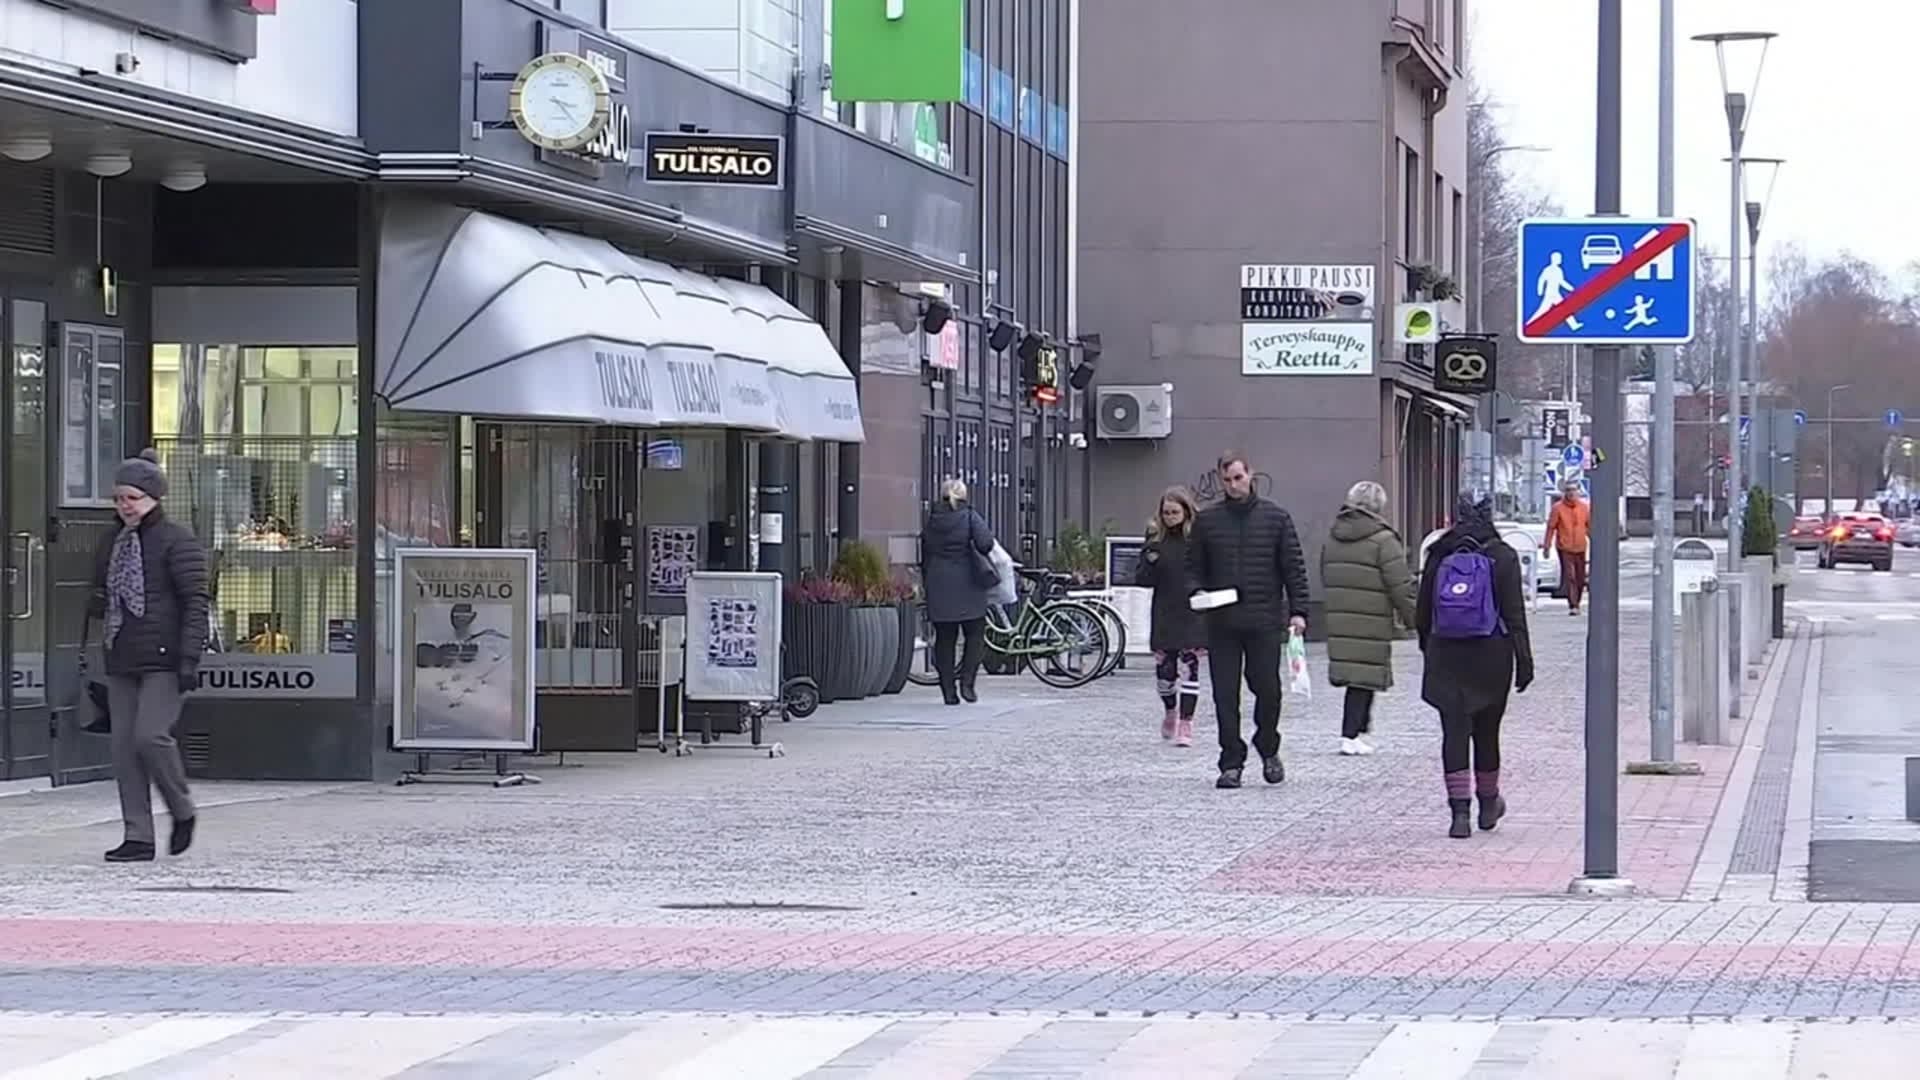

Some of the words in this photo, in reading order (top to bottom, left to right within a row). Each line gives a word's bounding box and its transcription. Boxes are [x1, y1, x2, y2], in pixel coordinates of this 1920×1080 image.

[653, 152, 772, 175] TULISALO
[1247, 266, 1302, 288] PIKKU
[1309, 266, 1371, 288] PAUSSI
[1248, 327, 1366, 353] Terveyskauppa
[1275, 348, 1341, 368] Reetta
[595, 352, 653, 411] TULISALO
[416, 582, 513, 599] TULISALO
[198, 670, 315, 689] TULISALO
